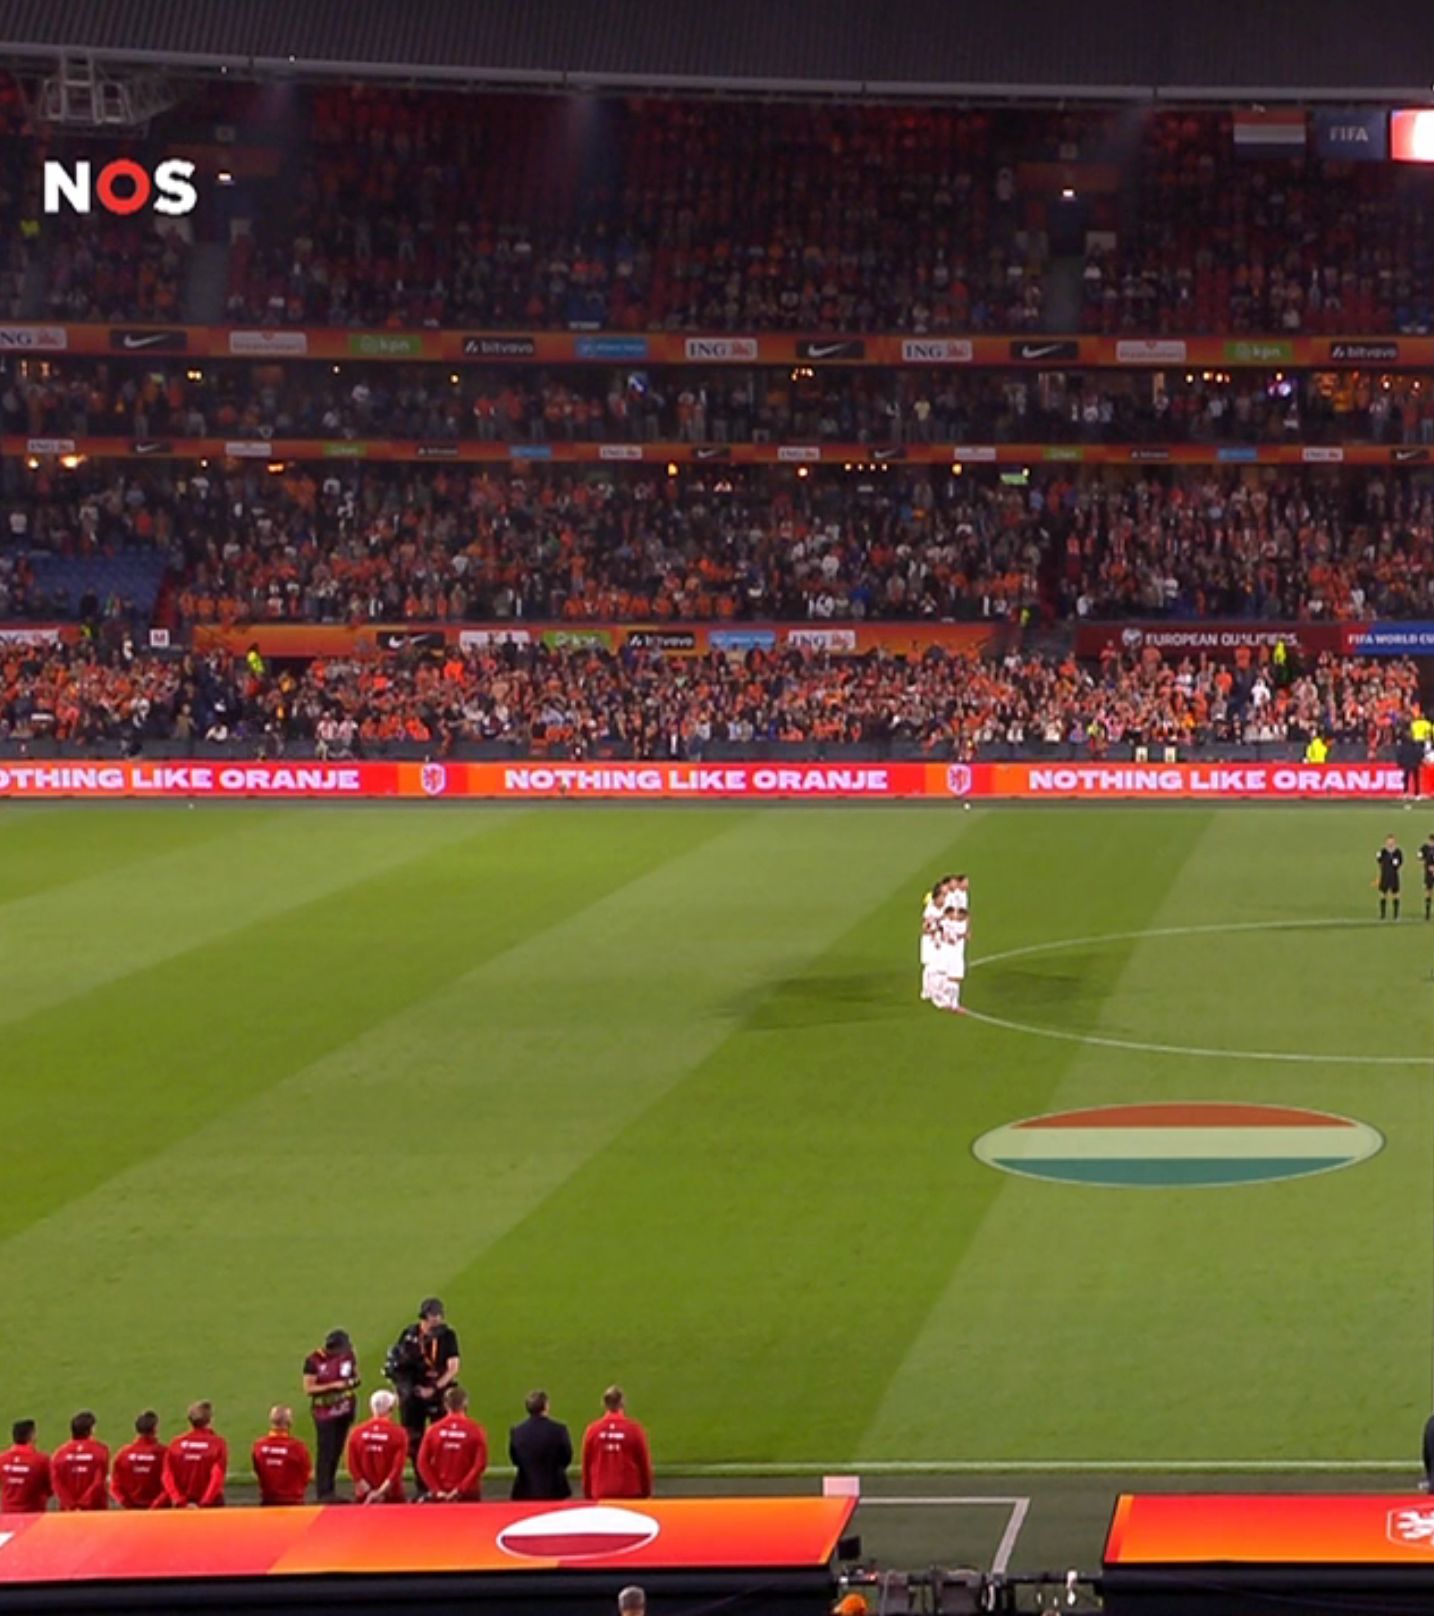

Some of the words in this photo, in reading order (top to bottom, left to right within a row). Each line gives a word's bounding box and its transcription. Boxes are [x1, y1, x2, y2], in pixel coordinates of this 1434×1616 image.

[1329, 126, 1369, 142] FIFA
[480, 340, 534, 354] bitvavo
[690, 341, 727, 357] ING
[905, 343, 942, 359] ING
[1346, 344, 1397, 359] bitvavo
[1145, 632, 1219, 645] EUROPEAN
[1348, 633, 1373, 644] FIFA
[1375, 633, 1418, 644] WORLD
[132, 768, 212, 789] LIKE
[220, 768, 360, 789] ORANJE
[504, 769, 663, 790] NOTHING
[669, 769, 746, 790] LIKE
[753, 769, 887, 791] ORANJE
[1029, 769, 1183, 790] NOTHING
[1190, 769, 1267, 790] LIKE
[1273, 769, 1405, 790] ORANJE
